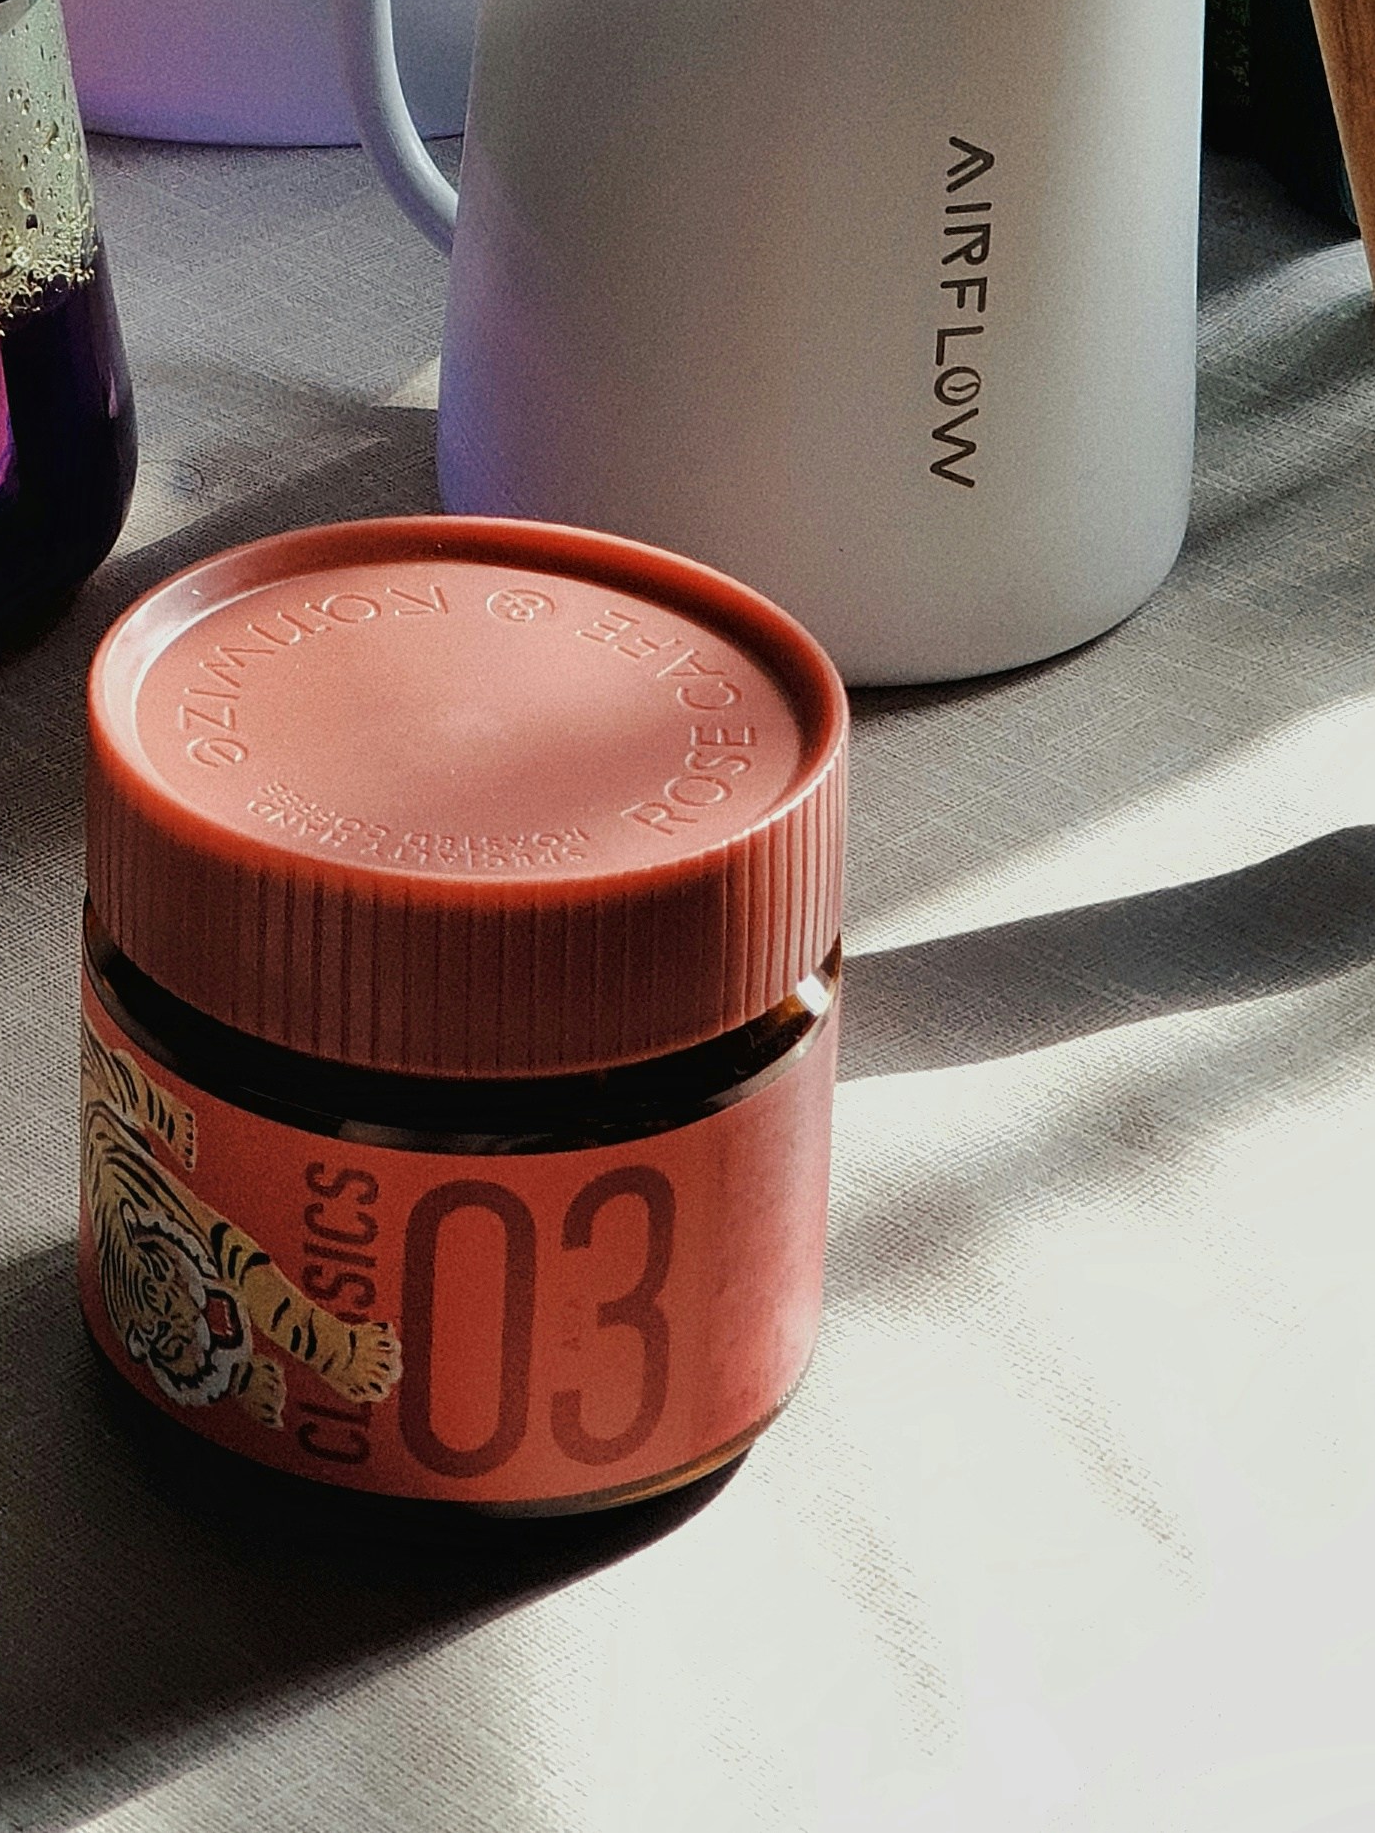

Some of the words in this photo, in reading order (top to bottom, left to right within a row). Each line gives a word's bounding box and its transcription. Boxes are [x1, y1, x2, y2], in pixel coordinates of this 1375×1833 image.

[929, 135, 996, 489] AIRFLOW
[575, 609, 744, 713] CAFE
[620, 722, 757, 836] ROSE
[296, 1160, 380, 1465] CLSICS
[398, 1164, 676, 1477] 03
